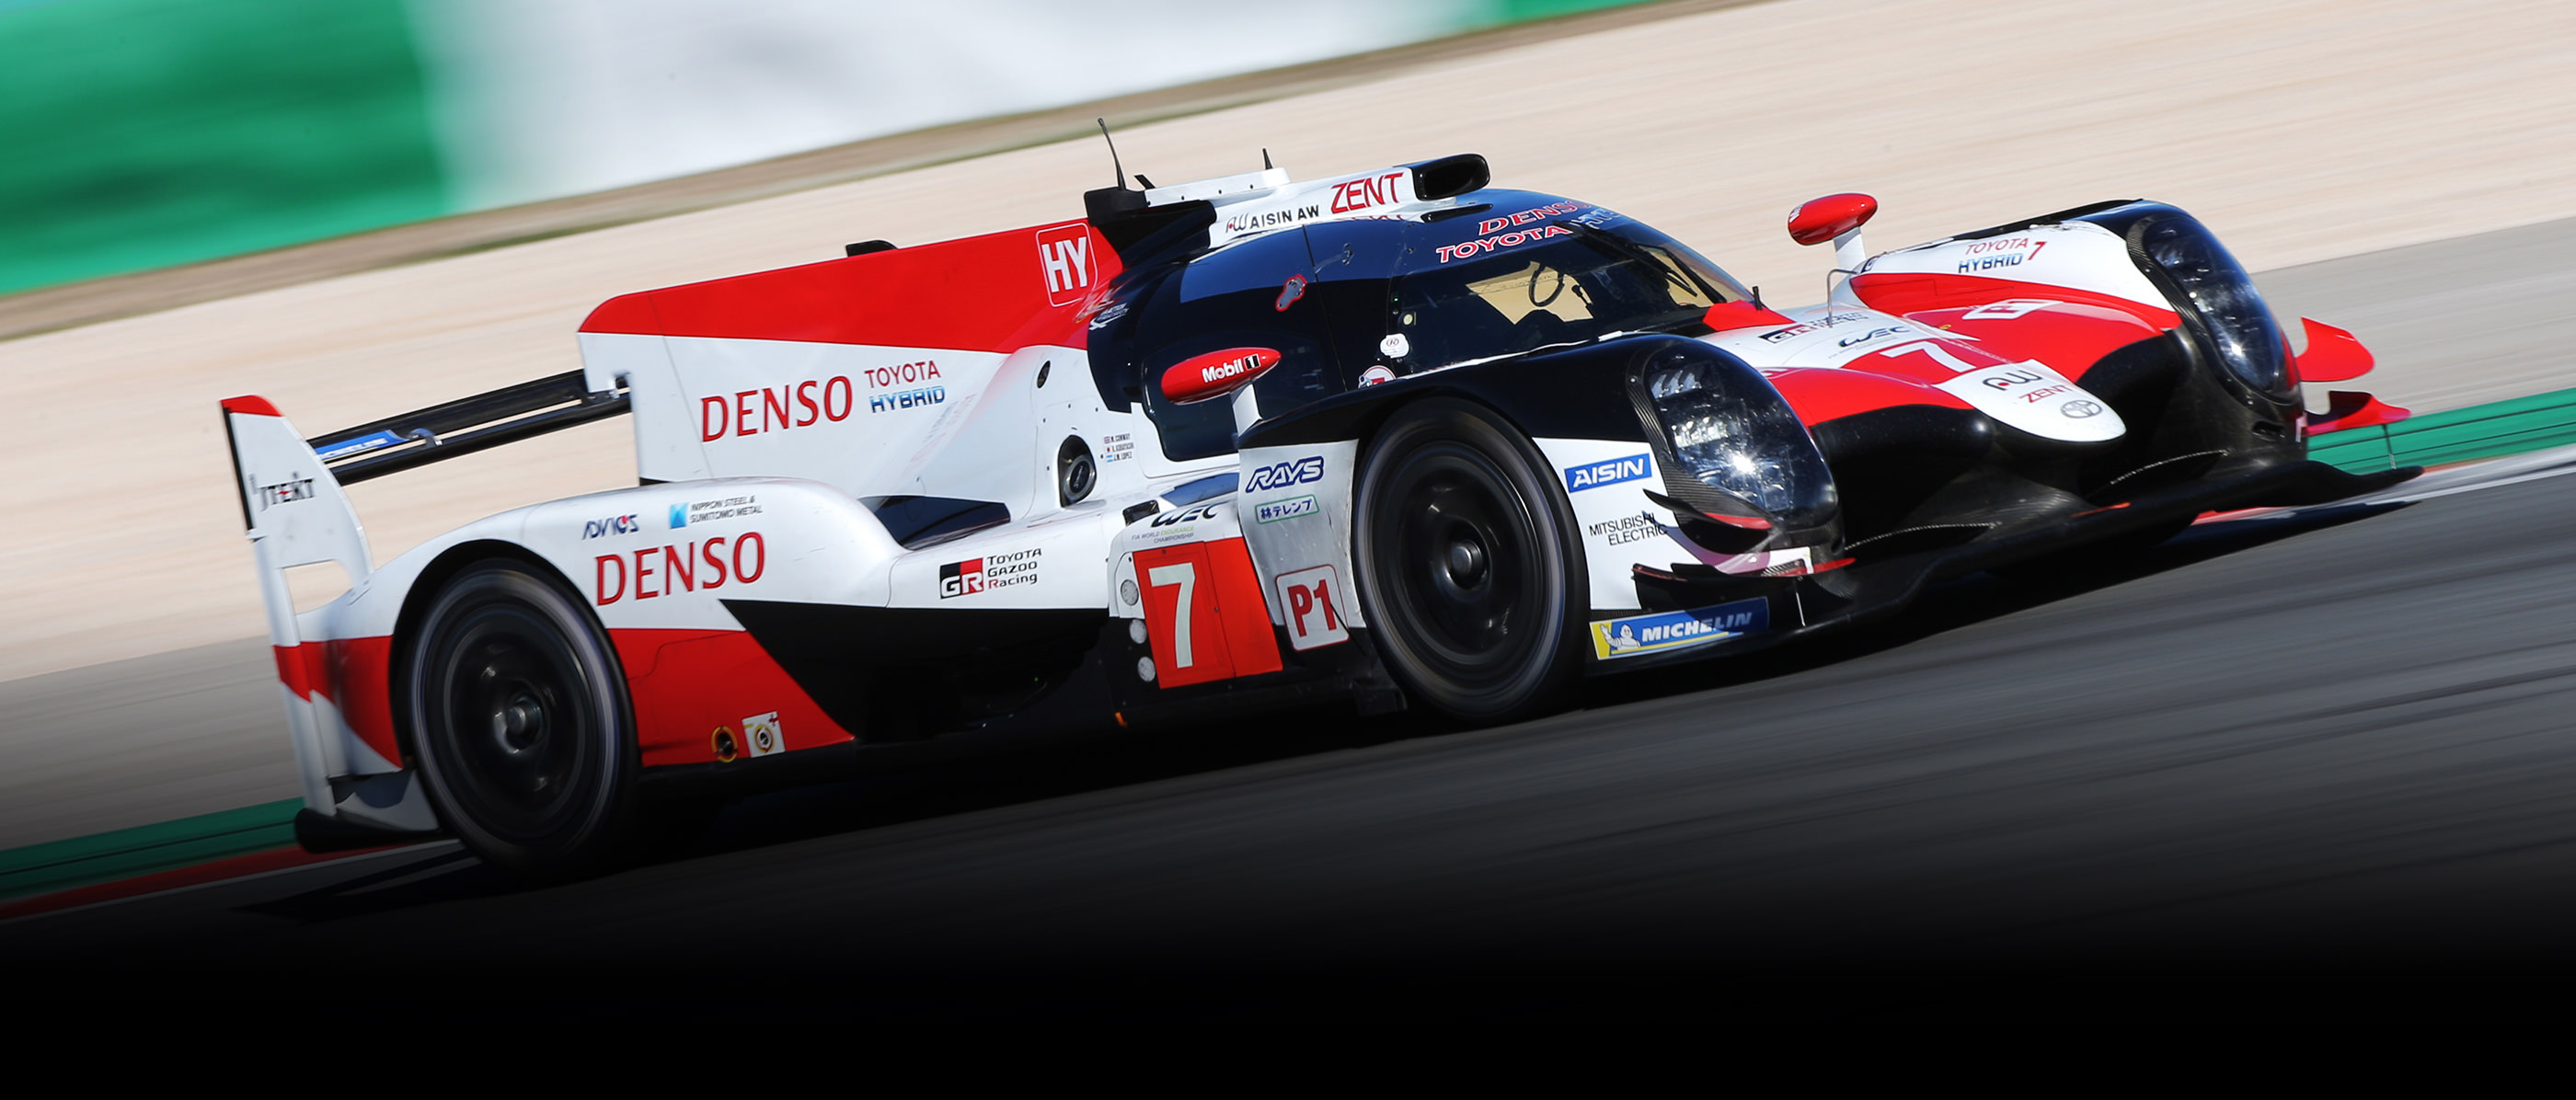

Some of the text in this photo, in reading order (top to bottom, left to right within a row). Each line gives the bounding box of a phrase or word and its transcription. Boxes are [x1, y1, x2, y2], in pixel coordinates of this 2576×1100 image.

[1330, 172, 1404, 213] ZENT
[1250, 210, 1292, 229] AISIN
[1297, 205, 1319, 220] AW
[1436, 224, 1573, 263] TOYOTA
[1965, 238, 2047, 260] TOYOTA 7
[1041, 236, 1087, 293] HY
[1958, 253, 2023, 273] HYBRID
[1879, 341, 1977, 372] 7
[864, 361, 941, 388] TOYOTA
[1202, 359, 1244, 383] Mobil
[869, 385, 946, 413] HYBRID
[2018, 384, 2072, 403] ZENT
[700, 375, 853, 442] DENSO
[1246, 456, 1324, 493] RAYS
[1573, 458, 1644, 487] AISIN
[690, 505, 763, 523] SUMITOMO METAL
[691, 499, 722, 511] NIPPON
[723, 497, 748, 507] STEEL
[1151, 499, 1230, 528] WEC
[1607, 524, 1668, 545] ELECTRIC
[594, 532, 765, 606] DENSO
[987, 548, 1041, 566] TOYOTA
[987, 561, 1038, 578] GAZOO
[941, 571, 983, 598] GR
[988, 574, 1038, 590] Racing
[1149, 562, 1196, 670] 7
[1287, 579, 1337, 637] P1
[1642, 612, 1752, 642] MICHELIN
